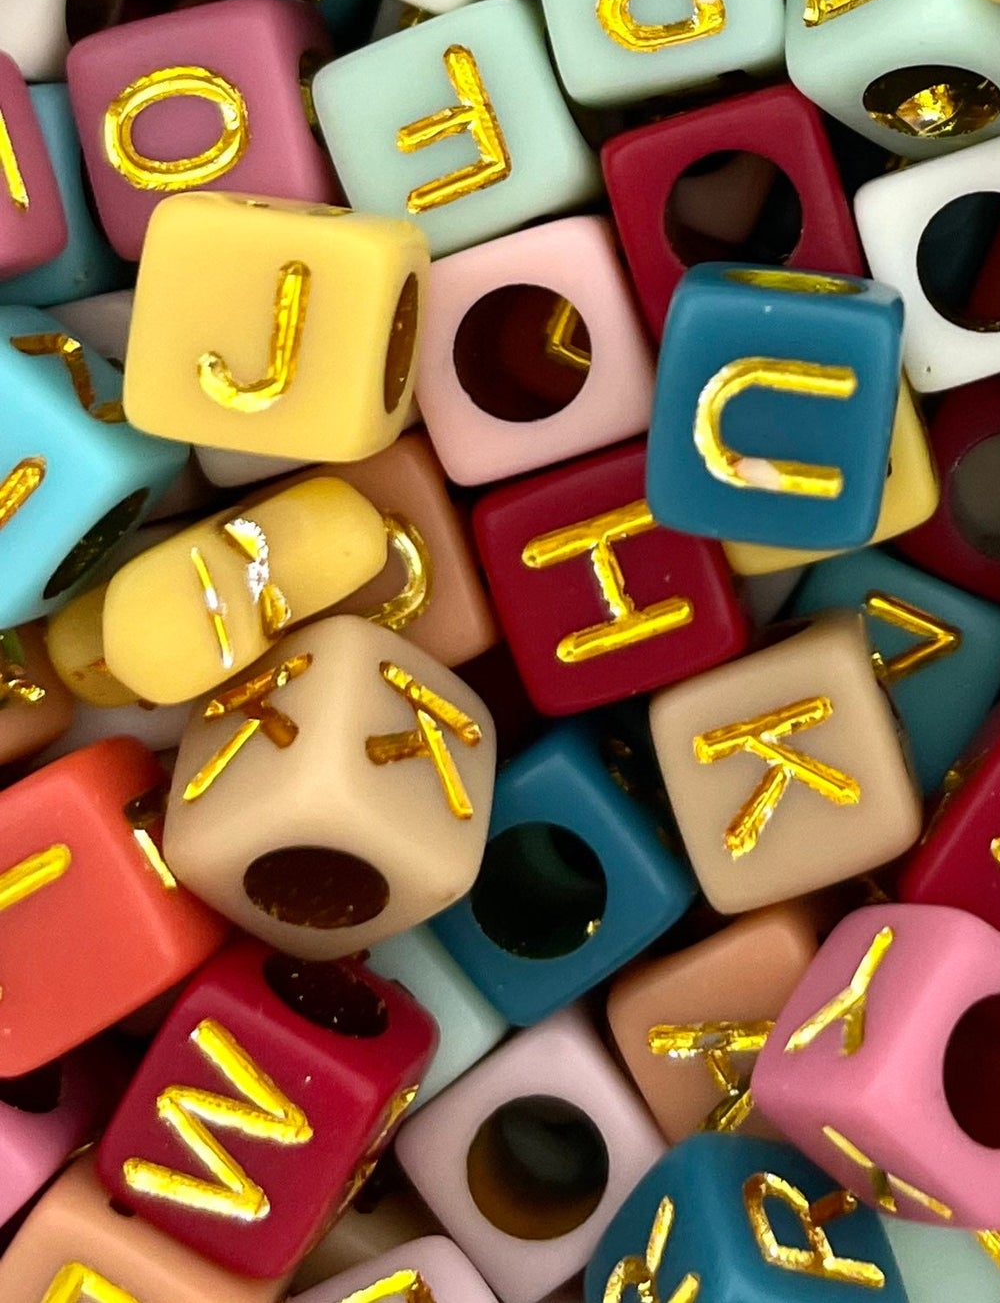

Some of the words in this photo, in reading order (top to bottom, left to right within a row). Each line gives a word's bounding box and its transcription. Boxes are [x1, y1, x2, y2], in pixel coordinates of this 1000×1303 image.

[104, 65, 251, 192] O
[396, 43, 512, 214] F
[196, 259, 313, 413] J
[693, 355, 859, 500] U
[520, 497, 695, 664] H
[692, 695, 862, 860] K
[783, 924, 895, 1058] Y
[741, 1171, 886, 1289] R
